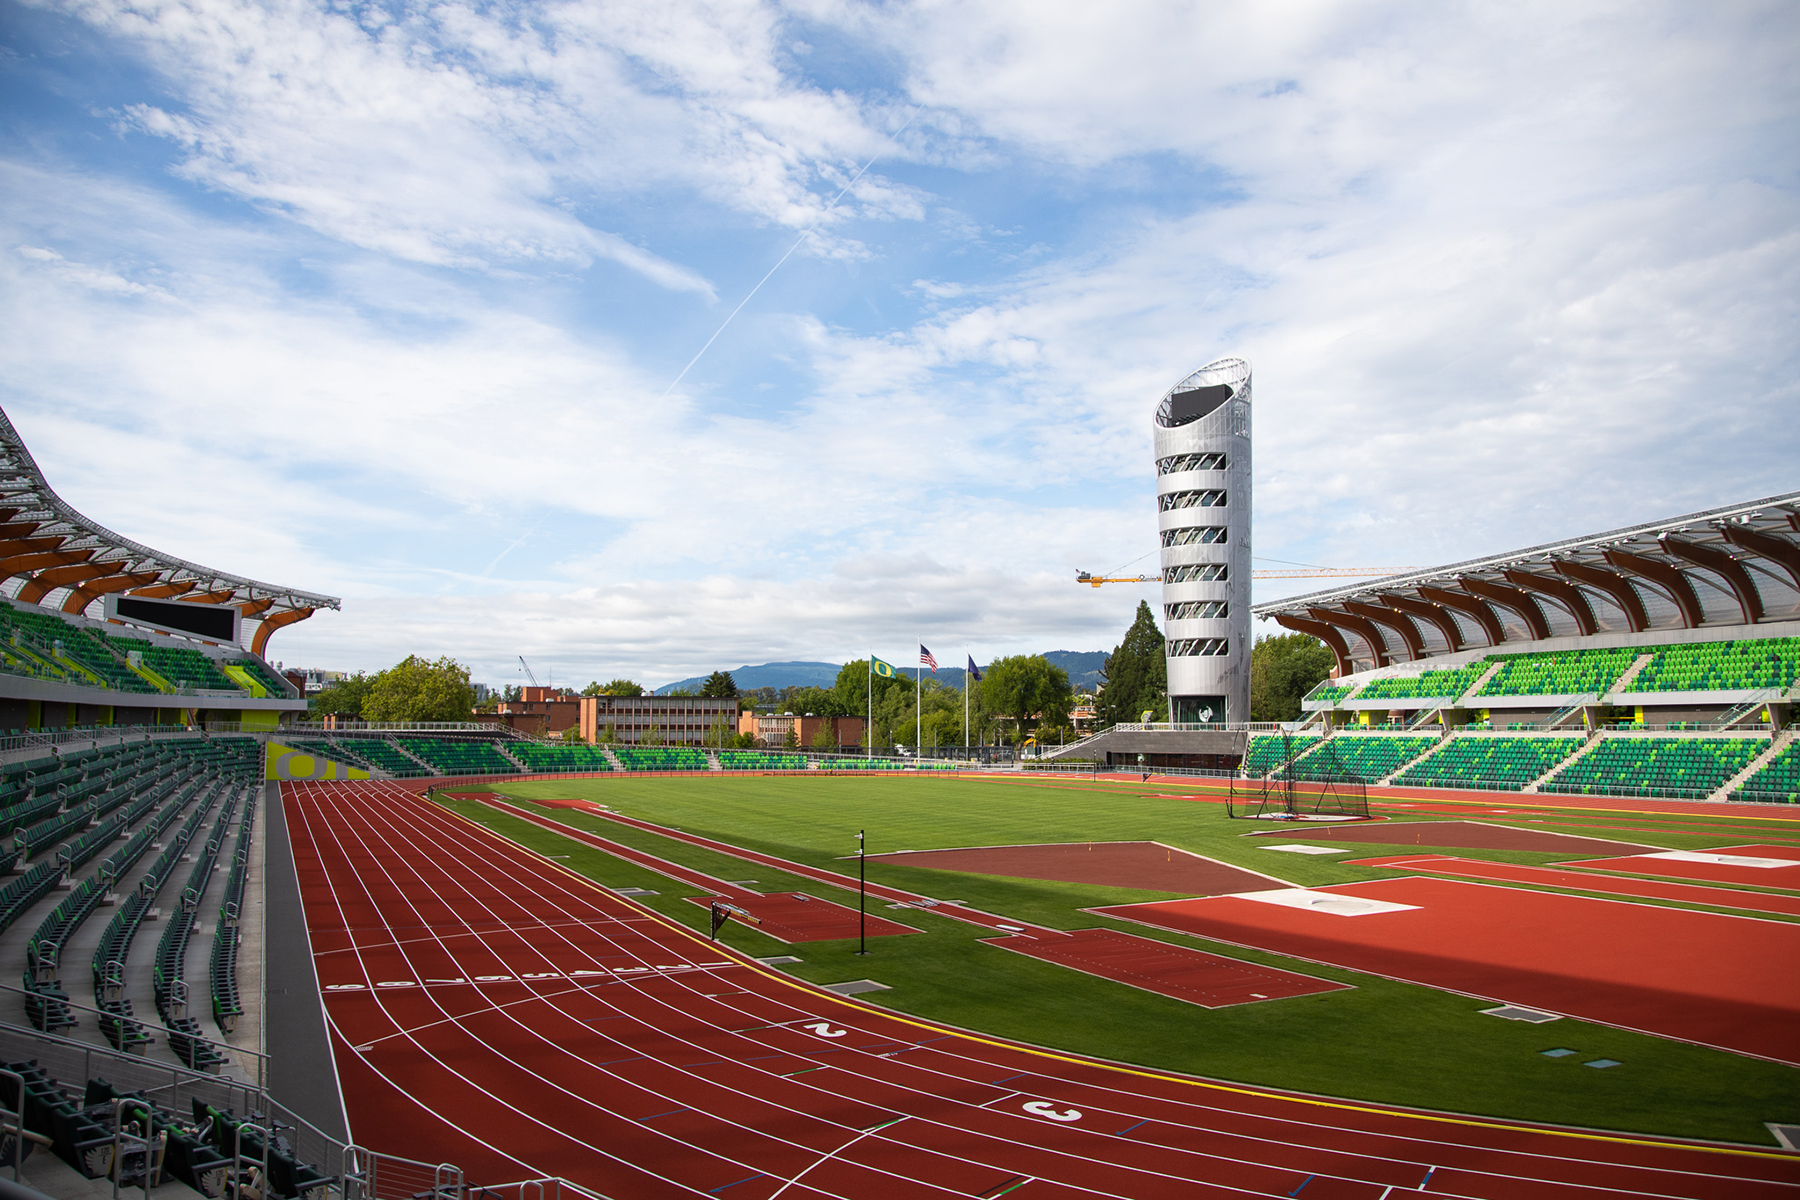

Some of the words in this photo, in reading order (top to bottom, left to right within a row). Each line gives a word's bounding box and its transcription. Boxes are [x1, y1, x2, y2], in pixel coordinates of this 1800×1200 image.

[874, 661, 891, 677] O
[803, 1023, 847, 1038] 2
[1022, 1101, 1082, 1121] 3
